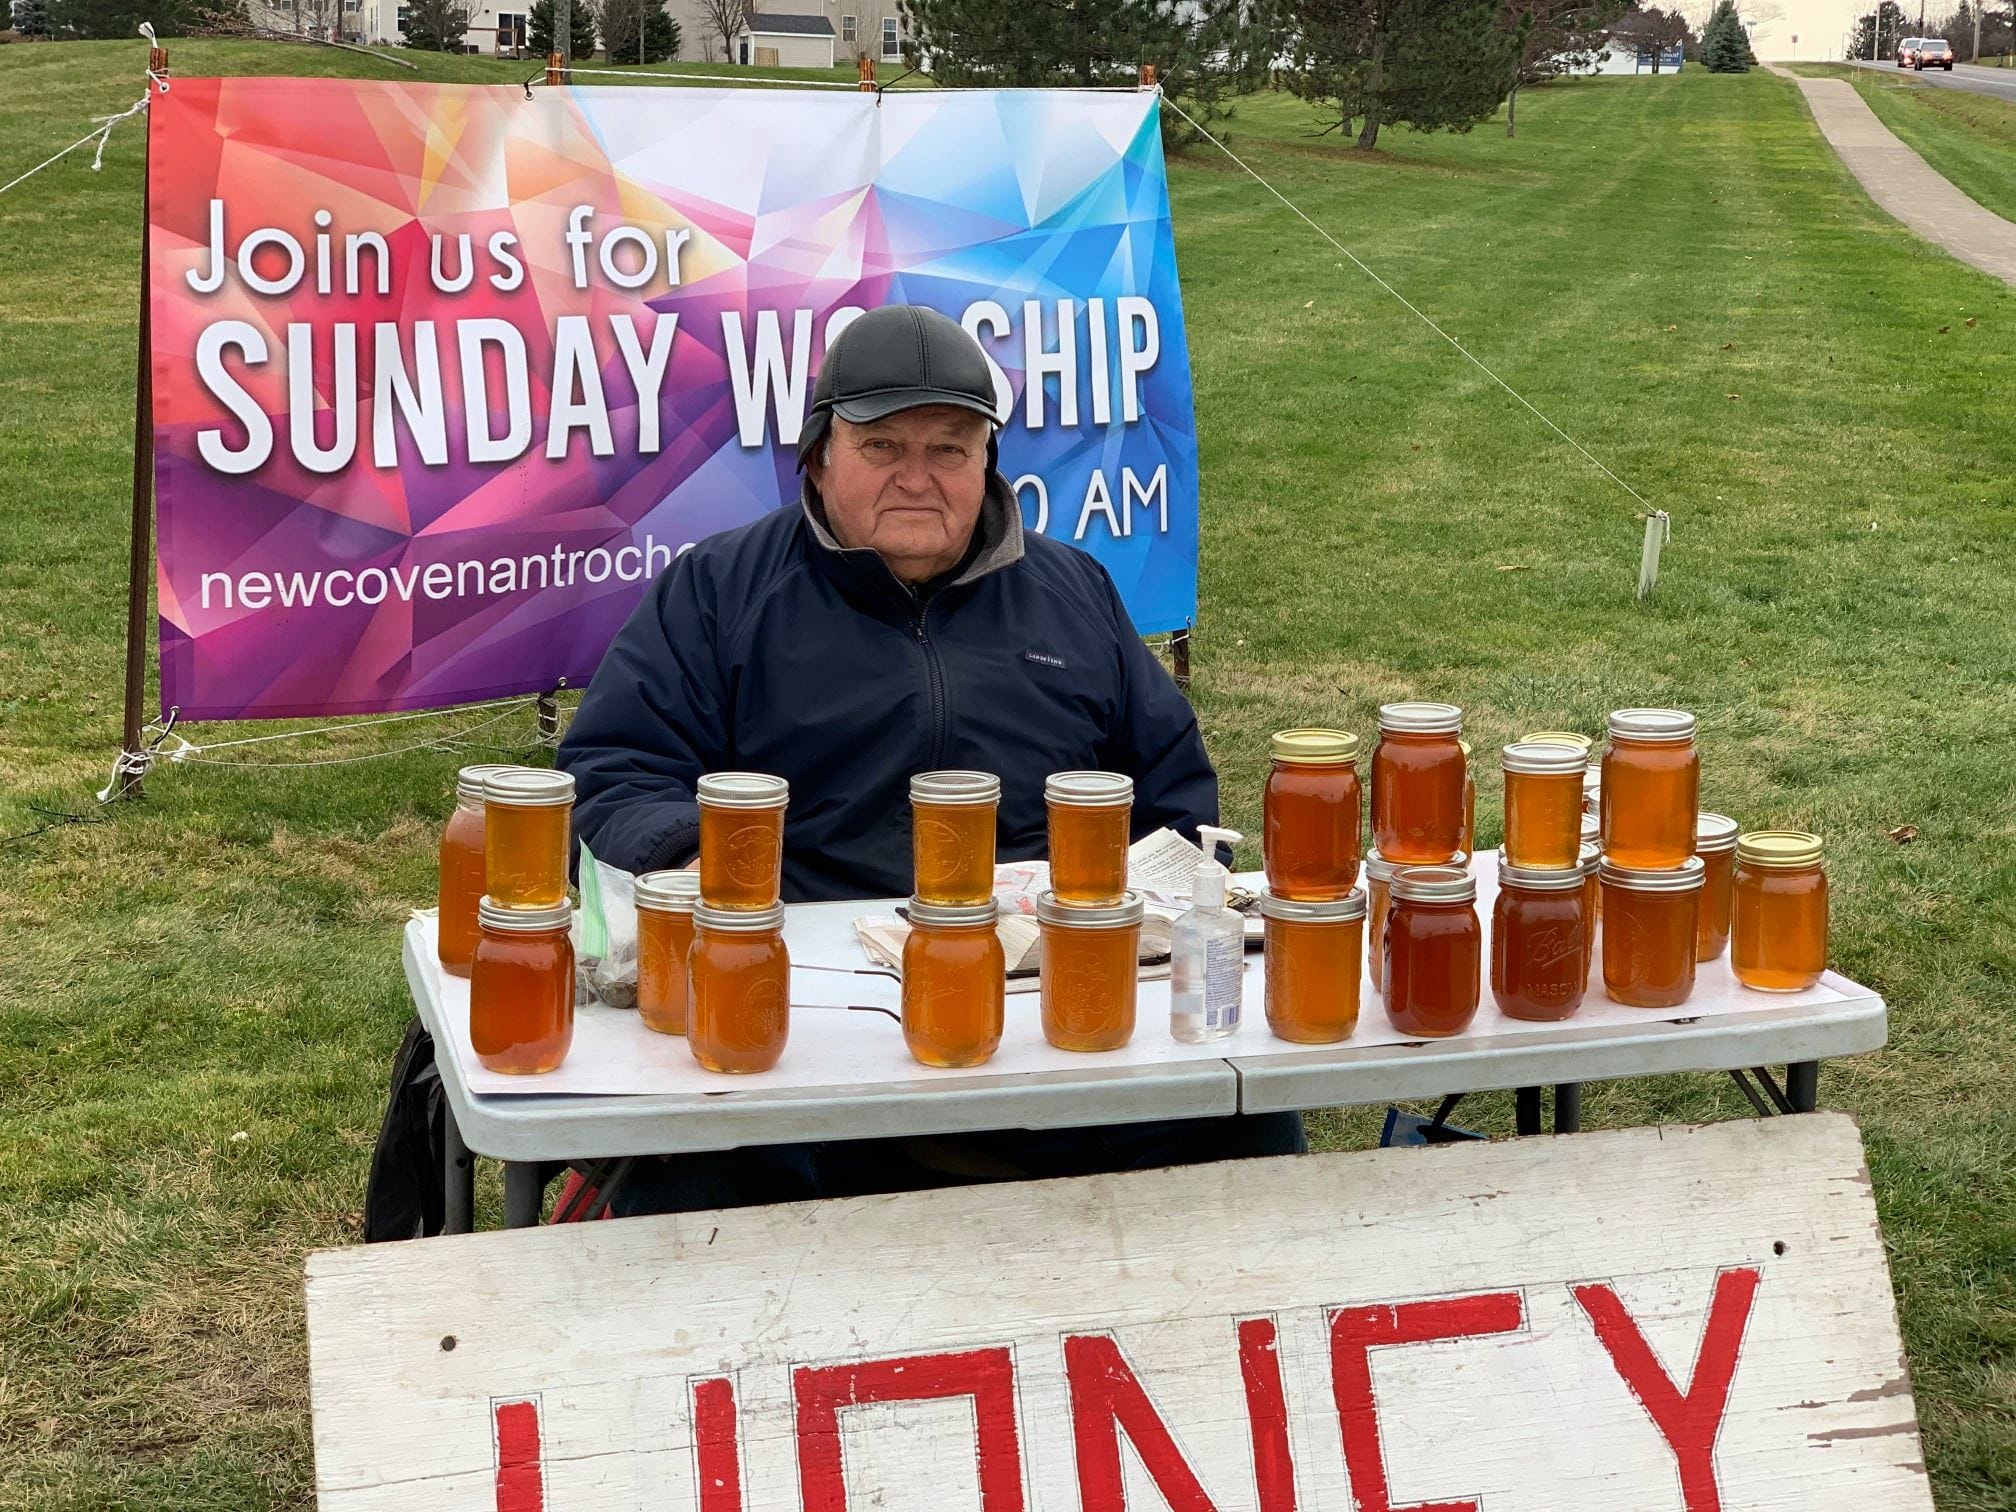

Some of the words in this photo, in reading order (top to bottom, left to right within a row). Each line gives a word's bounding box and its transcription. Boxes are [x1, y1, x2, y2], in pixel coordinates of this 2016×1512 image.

[186, 198, 390, 296] Join
[430, 230, 524, 293] us
[566, 204, 690, 290] for
[195, 312, 679, 474] SUNDAY
[720, 296, 1160, 447] WSHIP
[1073, 463, 1168, 540] AM
[1525, 921, 1585, 971] Ball
